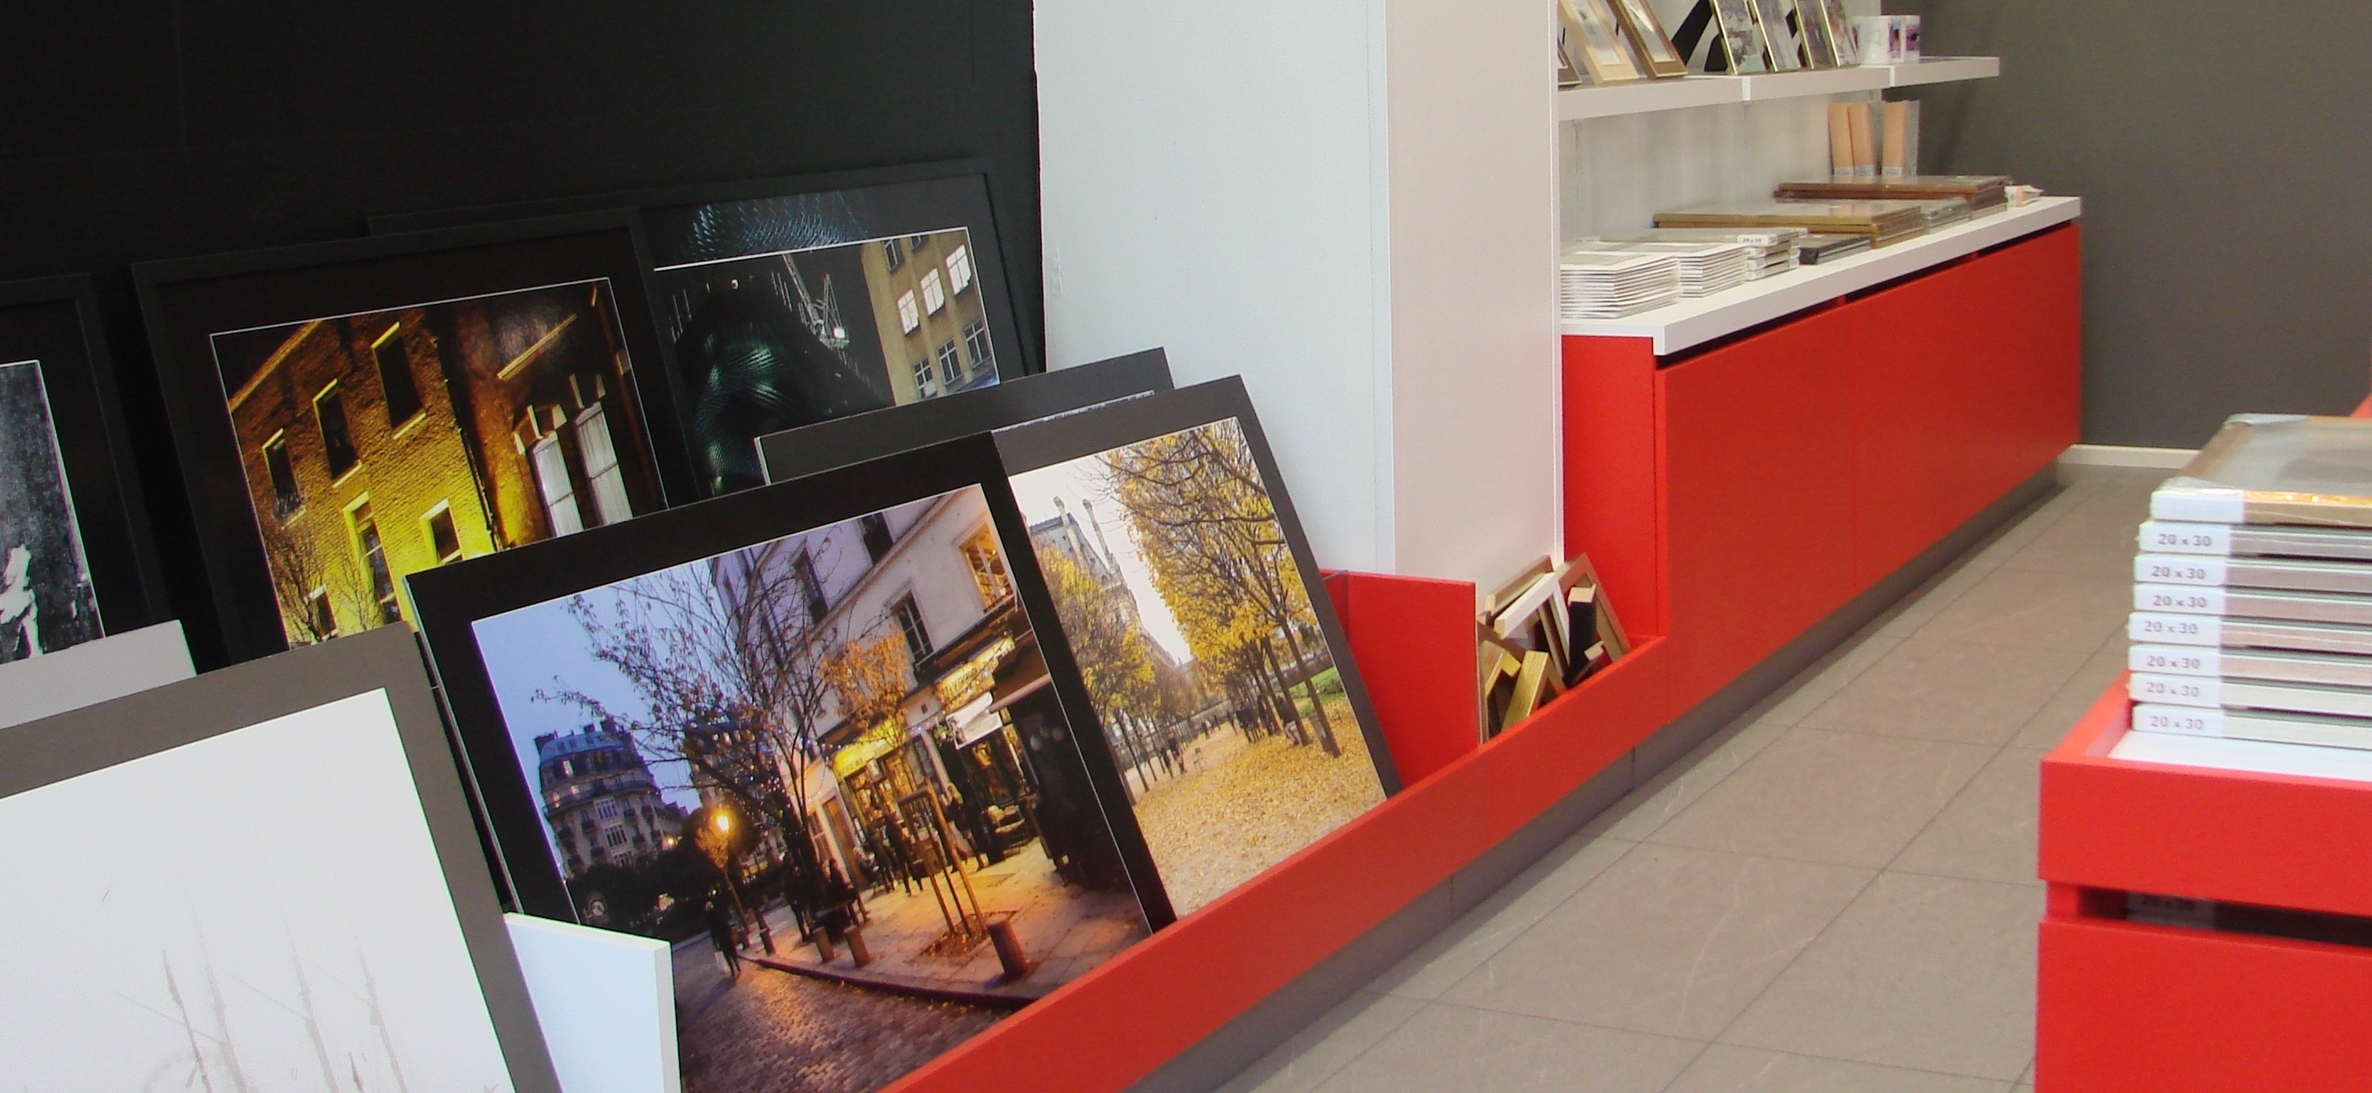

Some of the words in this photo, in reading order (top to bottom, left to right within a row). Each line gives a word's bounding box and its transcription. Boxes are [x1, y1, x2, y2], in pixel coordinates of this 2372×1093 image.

[2158, 533, 2177, 545] 20
[2193, 535, 2213, 547] 30
[2151, 566, 2171, 578] 20
[2186, 568, 2206, 580] 30
[2152, 595, 2172, 607] 20
[2188, 597, 2208, 609] 30
[2144, 621, 2163, 633] 20
[2179, 623, 2199, 635] 30
[2147, 656, 2166, 668] 20
[2182, 658, 2201, 670] 30
[2146, 682, 2165, 694] 20
[2181, 685, 2200, 698] 30
[2150, 716, 2169, 728] 20
[2185, 718, 2204, 730] 30
